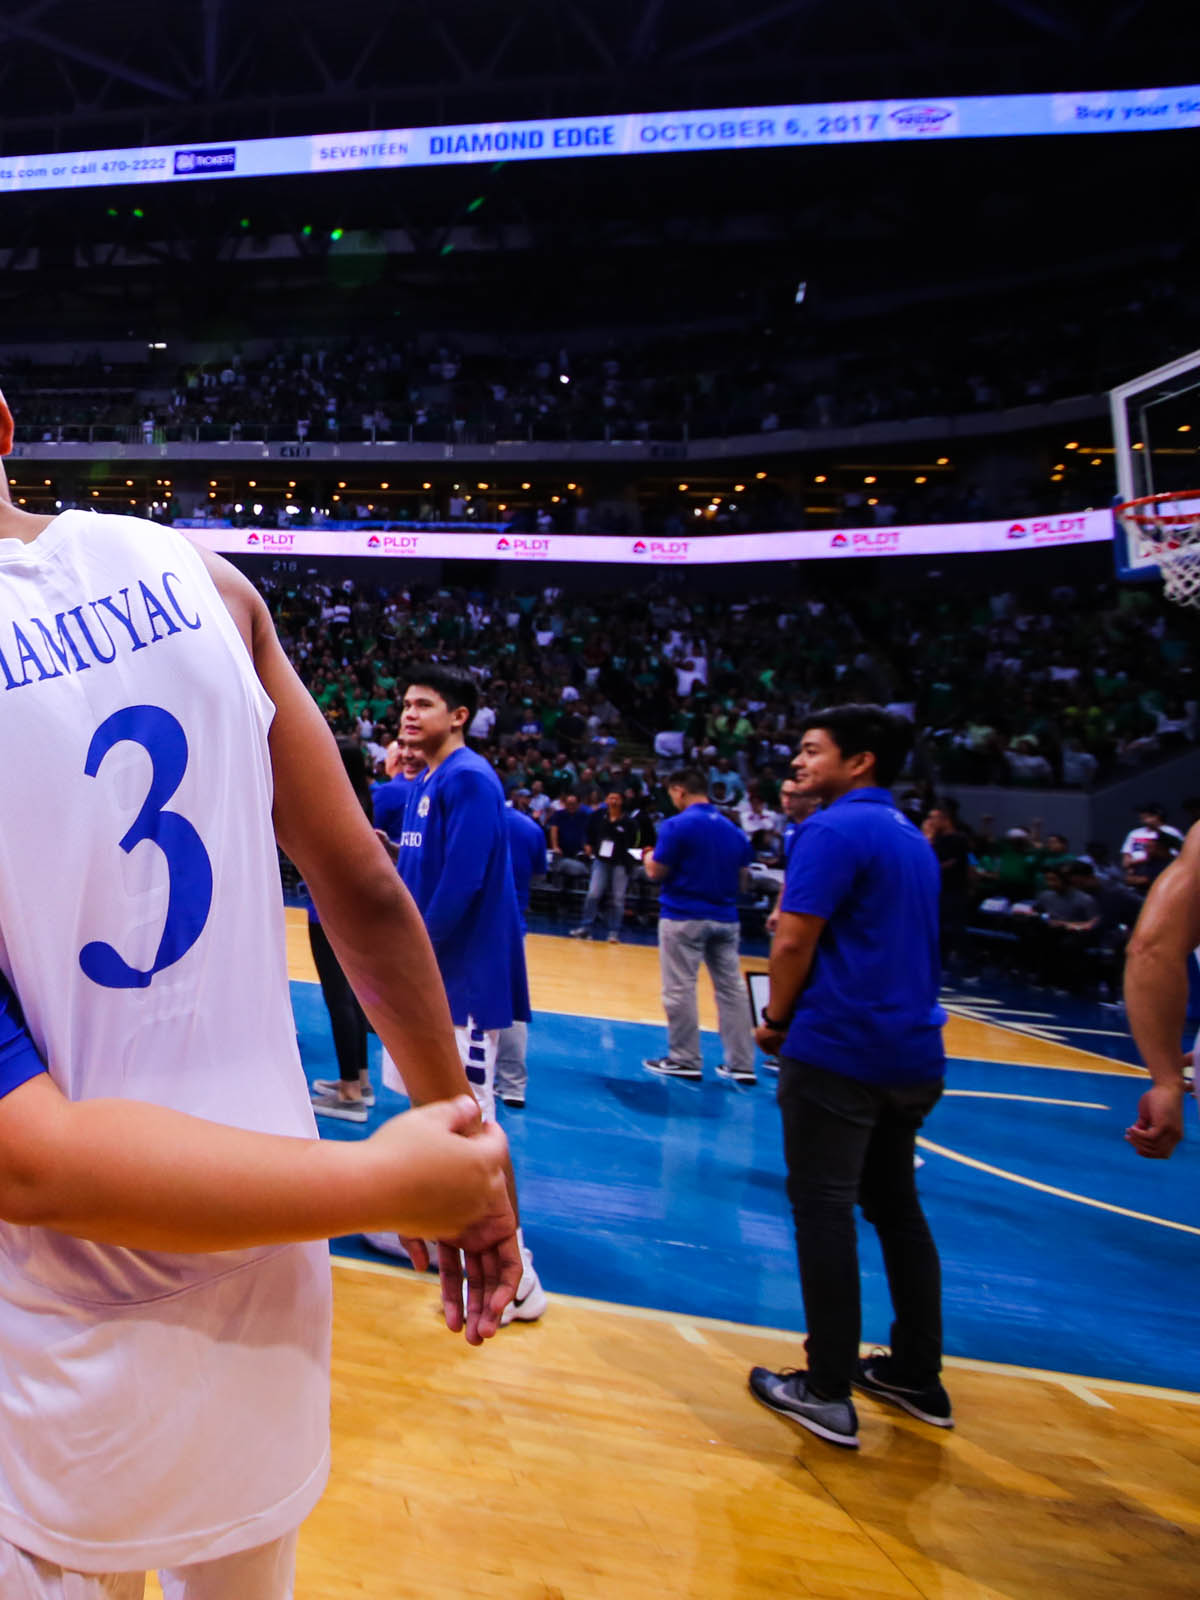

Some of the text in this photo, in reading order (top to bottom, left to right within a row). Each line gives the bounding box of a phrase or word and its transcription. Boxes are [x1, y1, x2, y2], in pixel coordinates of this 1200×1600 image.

[320, 141, 409, 160] SEVENTEEN
[429, 130, 545, 155] DIAMOND
[552, 125, 616, 148] EDGE
[640, 119, 776, 143] OCTOBER
[817, 114, 881, 135] 2017
[52, 166, 66, 176] or
[71, 162, 97, 174] call
[100, 158, 167, 172] 470-2222
[1032, 518, 1087, 534] PLDT
[263, 534, 296, 544] PLDT
[383, 536, 419, 547] PLDT
[514, 539, 551, 550] PLDT
[853, 532, 901, 545] PLDT
[650, 542, 689, 553] PLDT
[79, 704, 213, 988] 3
